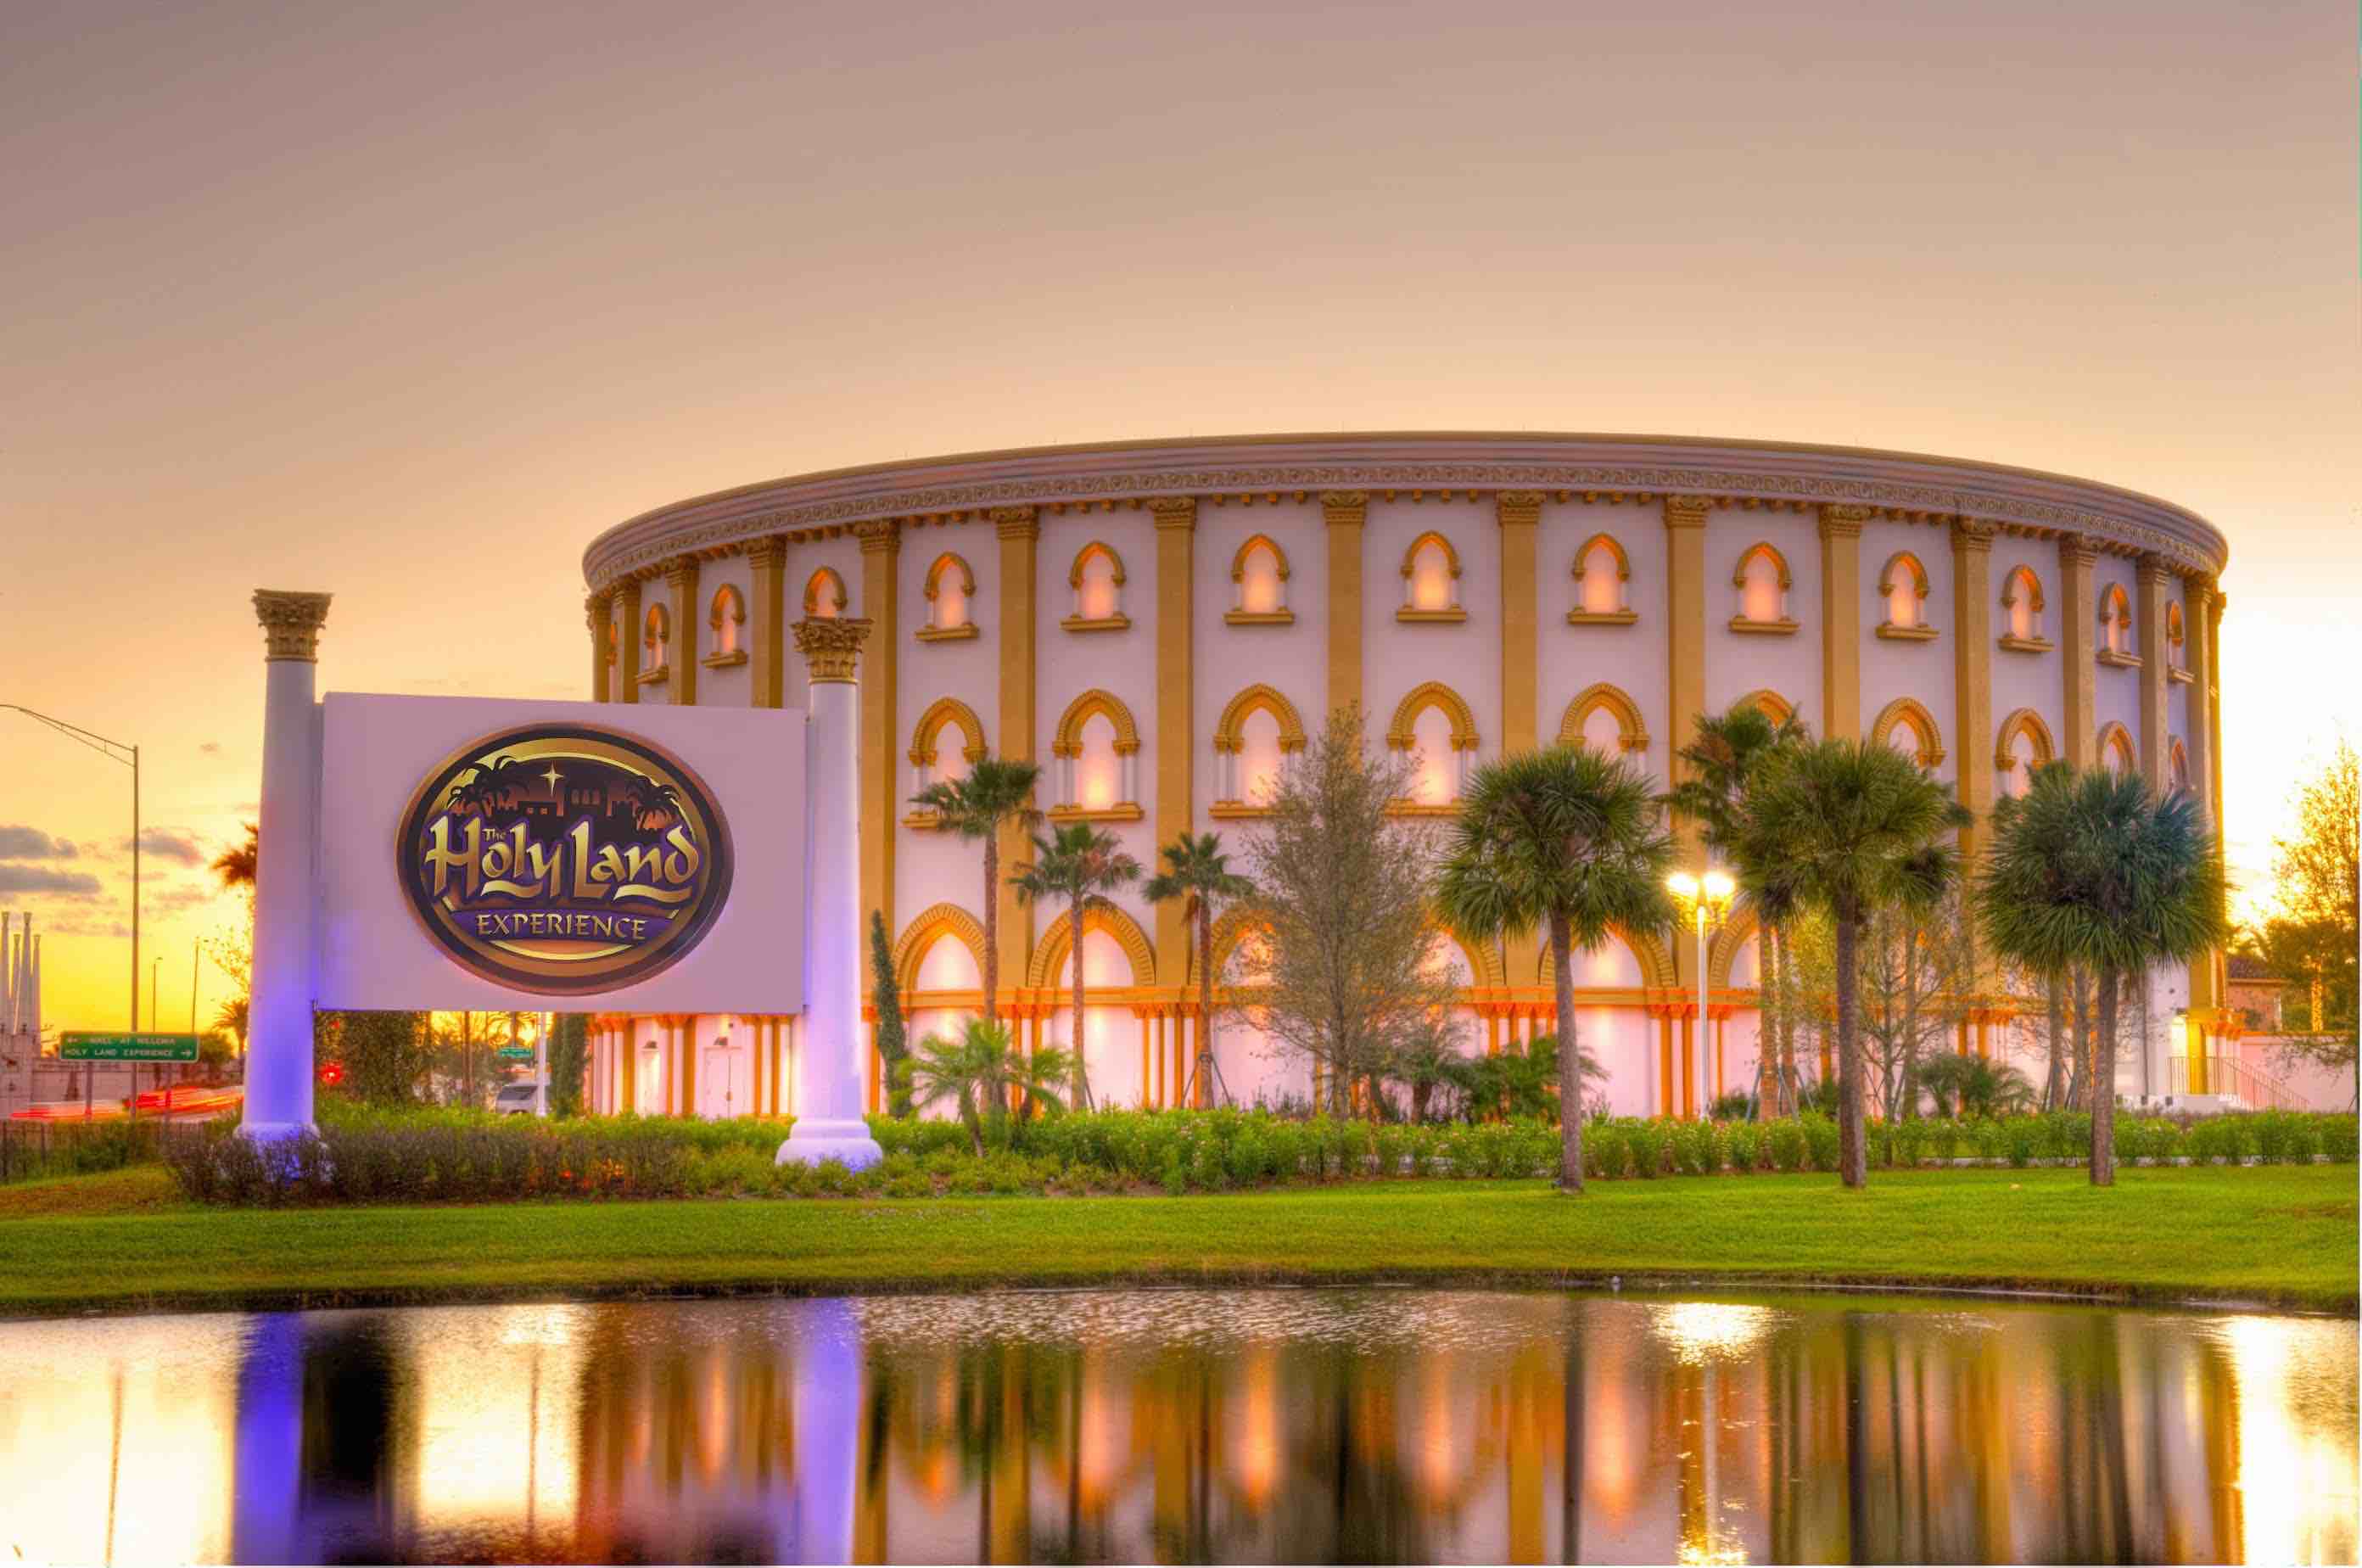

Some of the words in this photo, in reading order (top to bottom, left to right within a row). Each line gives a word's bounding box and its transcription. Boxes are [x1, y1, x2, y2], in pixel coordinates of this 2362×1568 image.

[482, 828, 507, 842] The
[425, 815, 563, 899] Holy
[571, 820, 700, 899] Land
[475, 913, 650, 941] EXPERIENCE
[64, 1048, 87, 1056] HOLY
[94, 1048, 117, 1056] LAND
[123, 1048, 174, 1056] EXPERIENCE
